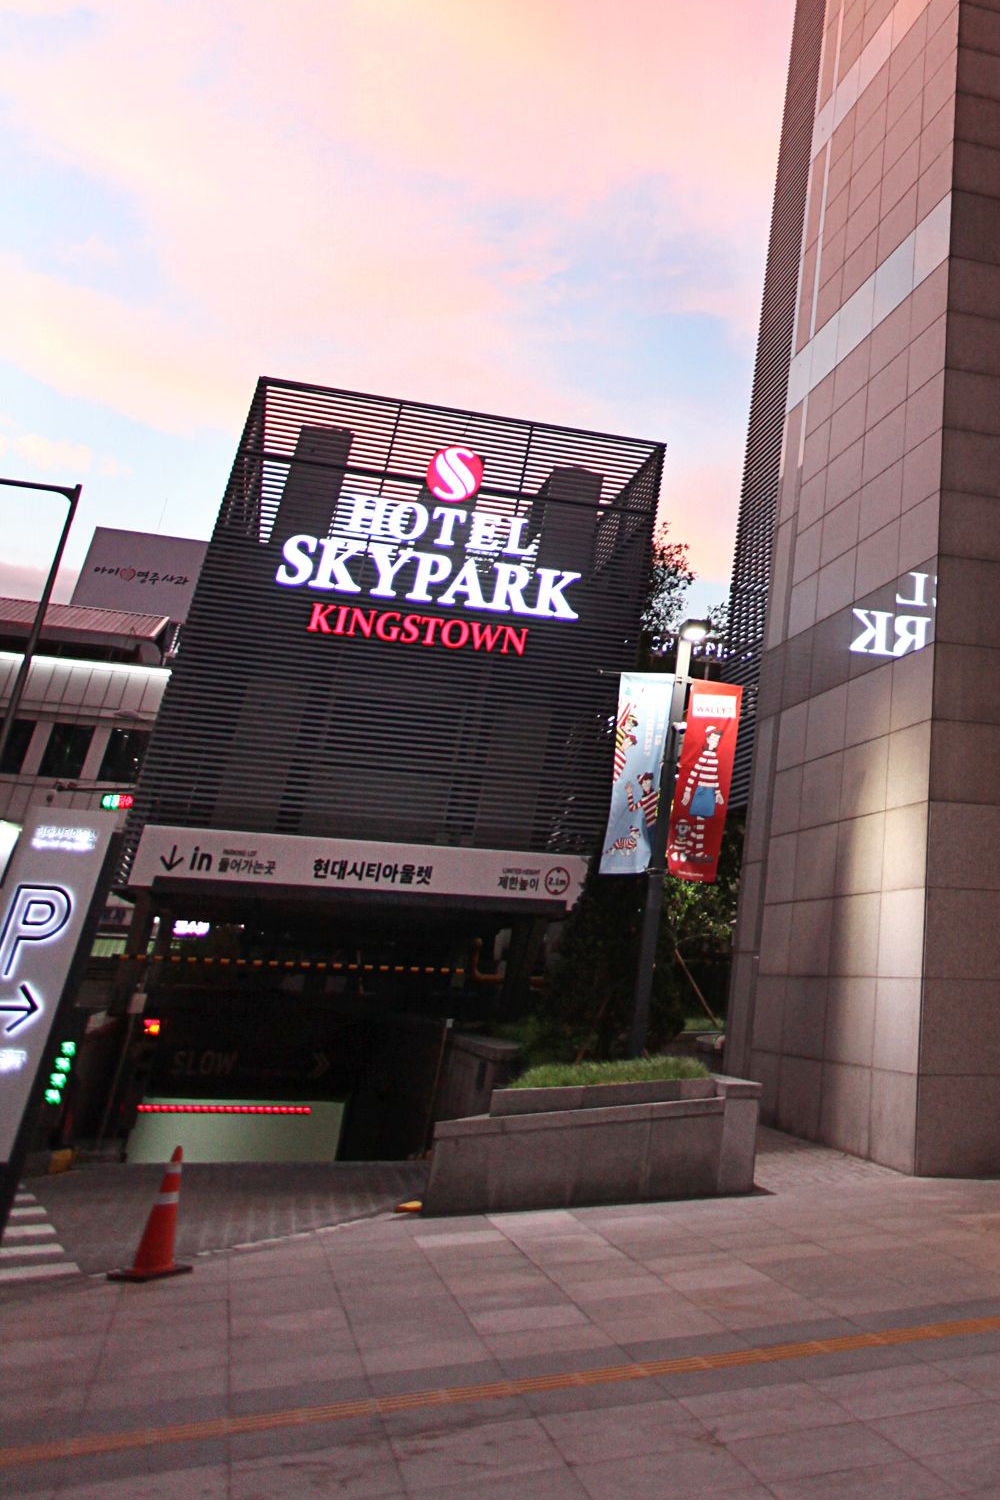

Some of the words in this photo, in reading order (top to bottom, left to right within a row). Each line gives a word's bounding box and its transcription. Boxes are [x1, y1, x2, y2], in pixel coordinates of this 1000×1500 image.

[342, 496, 538, 555] HOTEL
[275, 535, 582, 621] SKYPARK
[306, 602, 529, 656] KINGSTOWN
[189, 846, 212, 872] in
[218, 857, 276, 876] 들어가는곳
[313, 857, 433, 886] 현대시티아울렛
[497, 876, 539, 891] 제한높이
[0, 884, 73, 977] P
